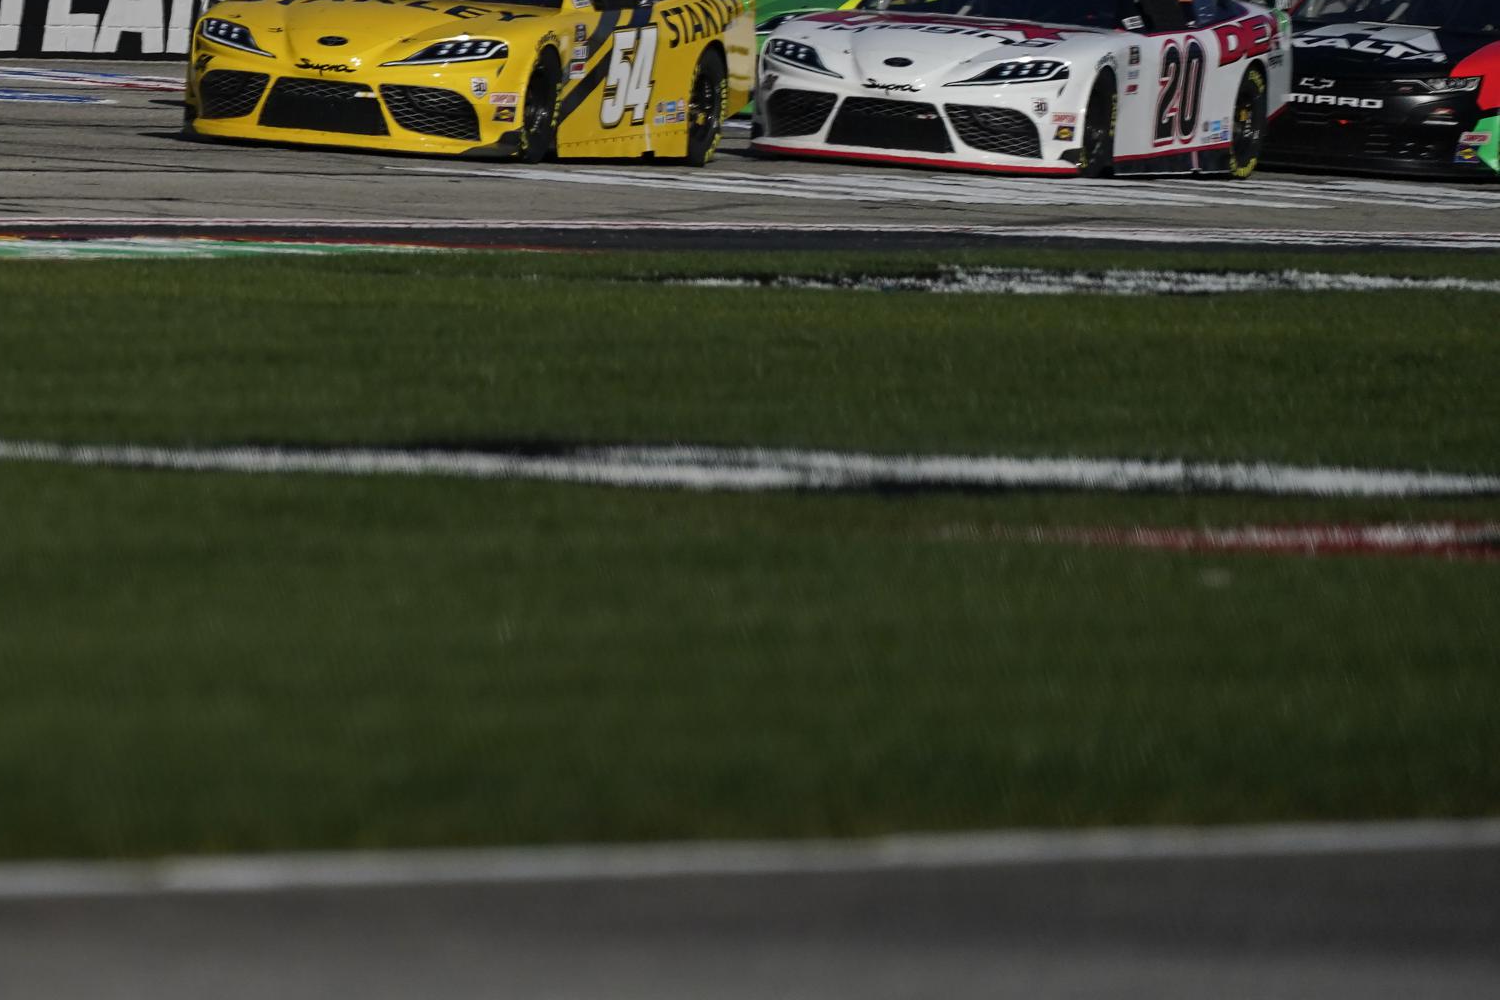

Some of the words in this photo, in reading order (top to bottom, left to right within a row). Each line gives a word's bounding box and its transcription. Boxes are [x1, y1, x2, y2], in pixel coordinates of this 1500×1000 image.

[294, 57, 357, 76] Supra
[600, 22, 657, 130] 54
[861, 77, 922, 97] Supra
[1152, 34, 1206, 147] 20
